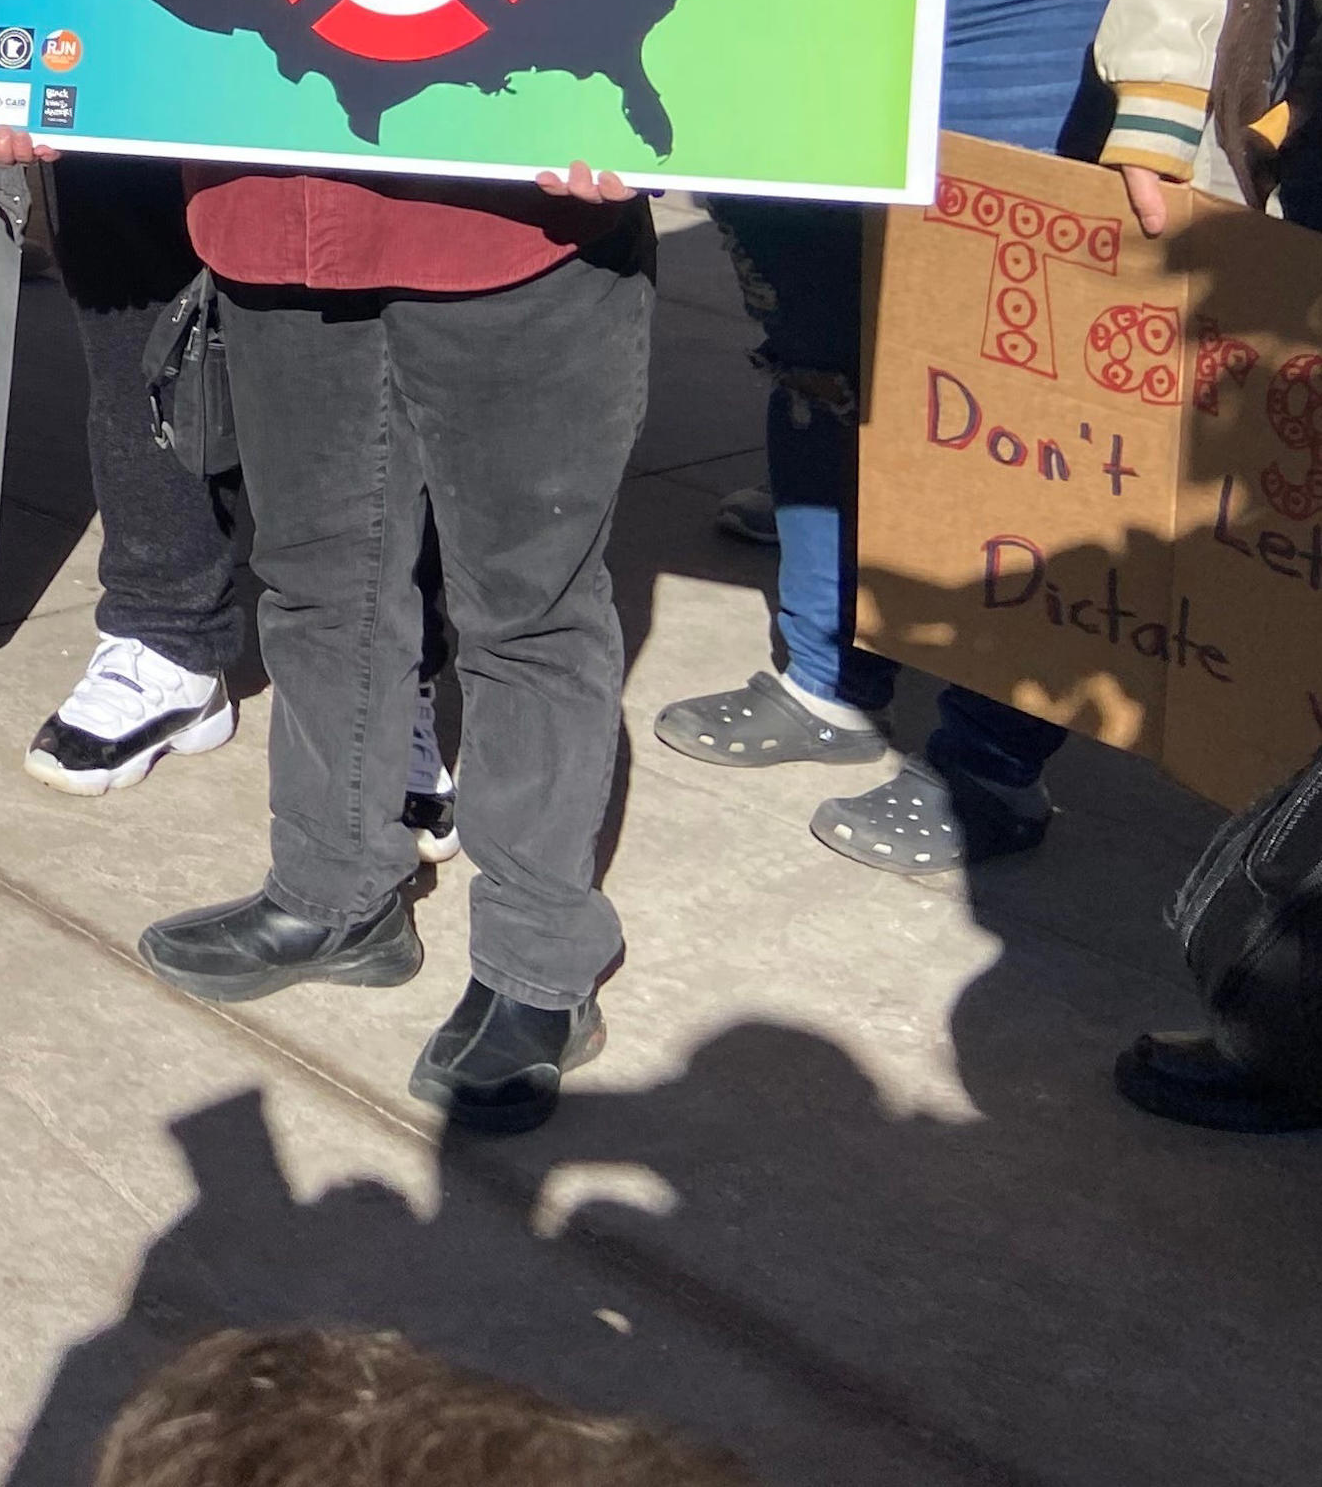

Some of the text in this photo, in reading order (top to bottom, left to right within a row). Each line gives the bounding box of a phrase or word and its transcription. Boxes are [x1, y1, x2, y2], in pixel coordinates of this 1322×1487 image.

[46, 40, 76, 55] RJN
[927, 366, 1137, 497] Don't
[982, 533, 1233, 684] Dictate
